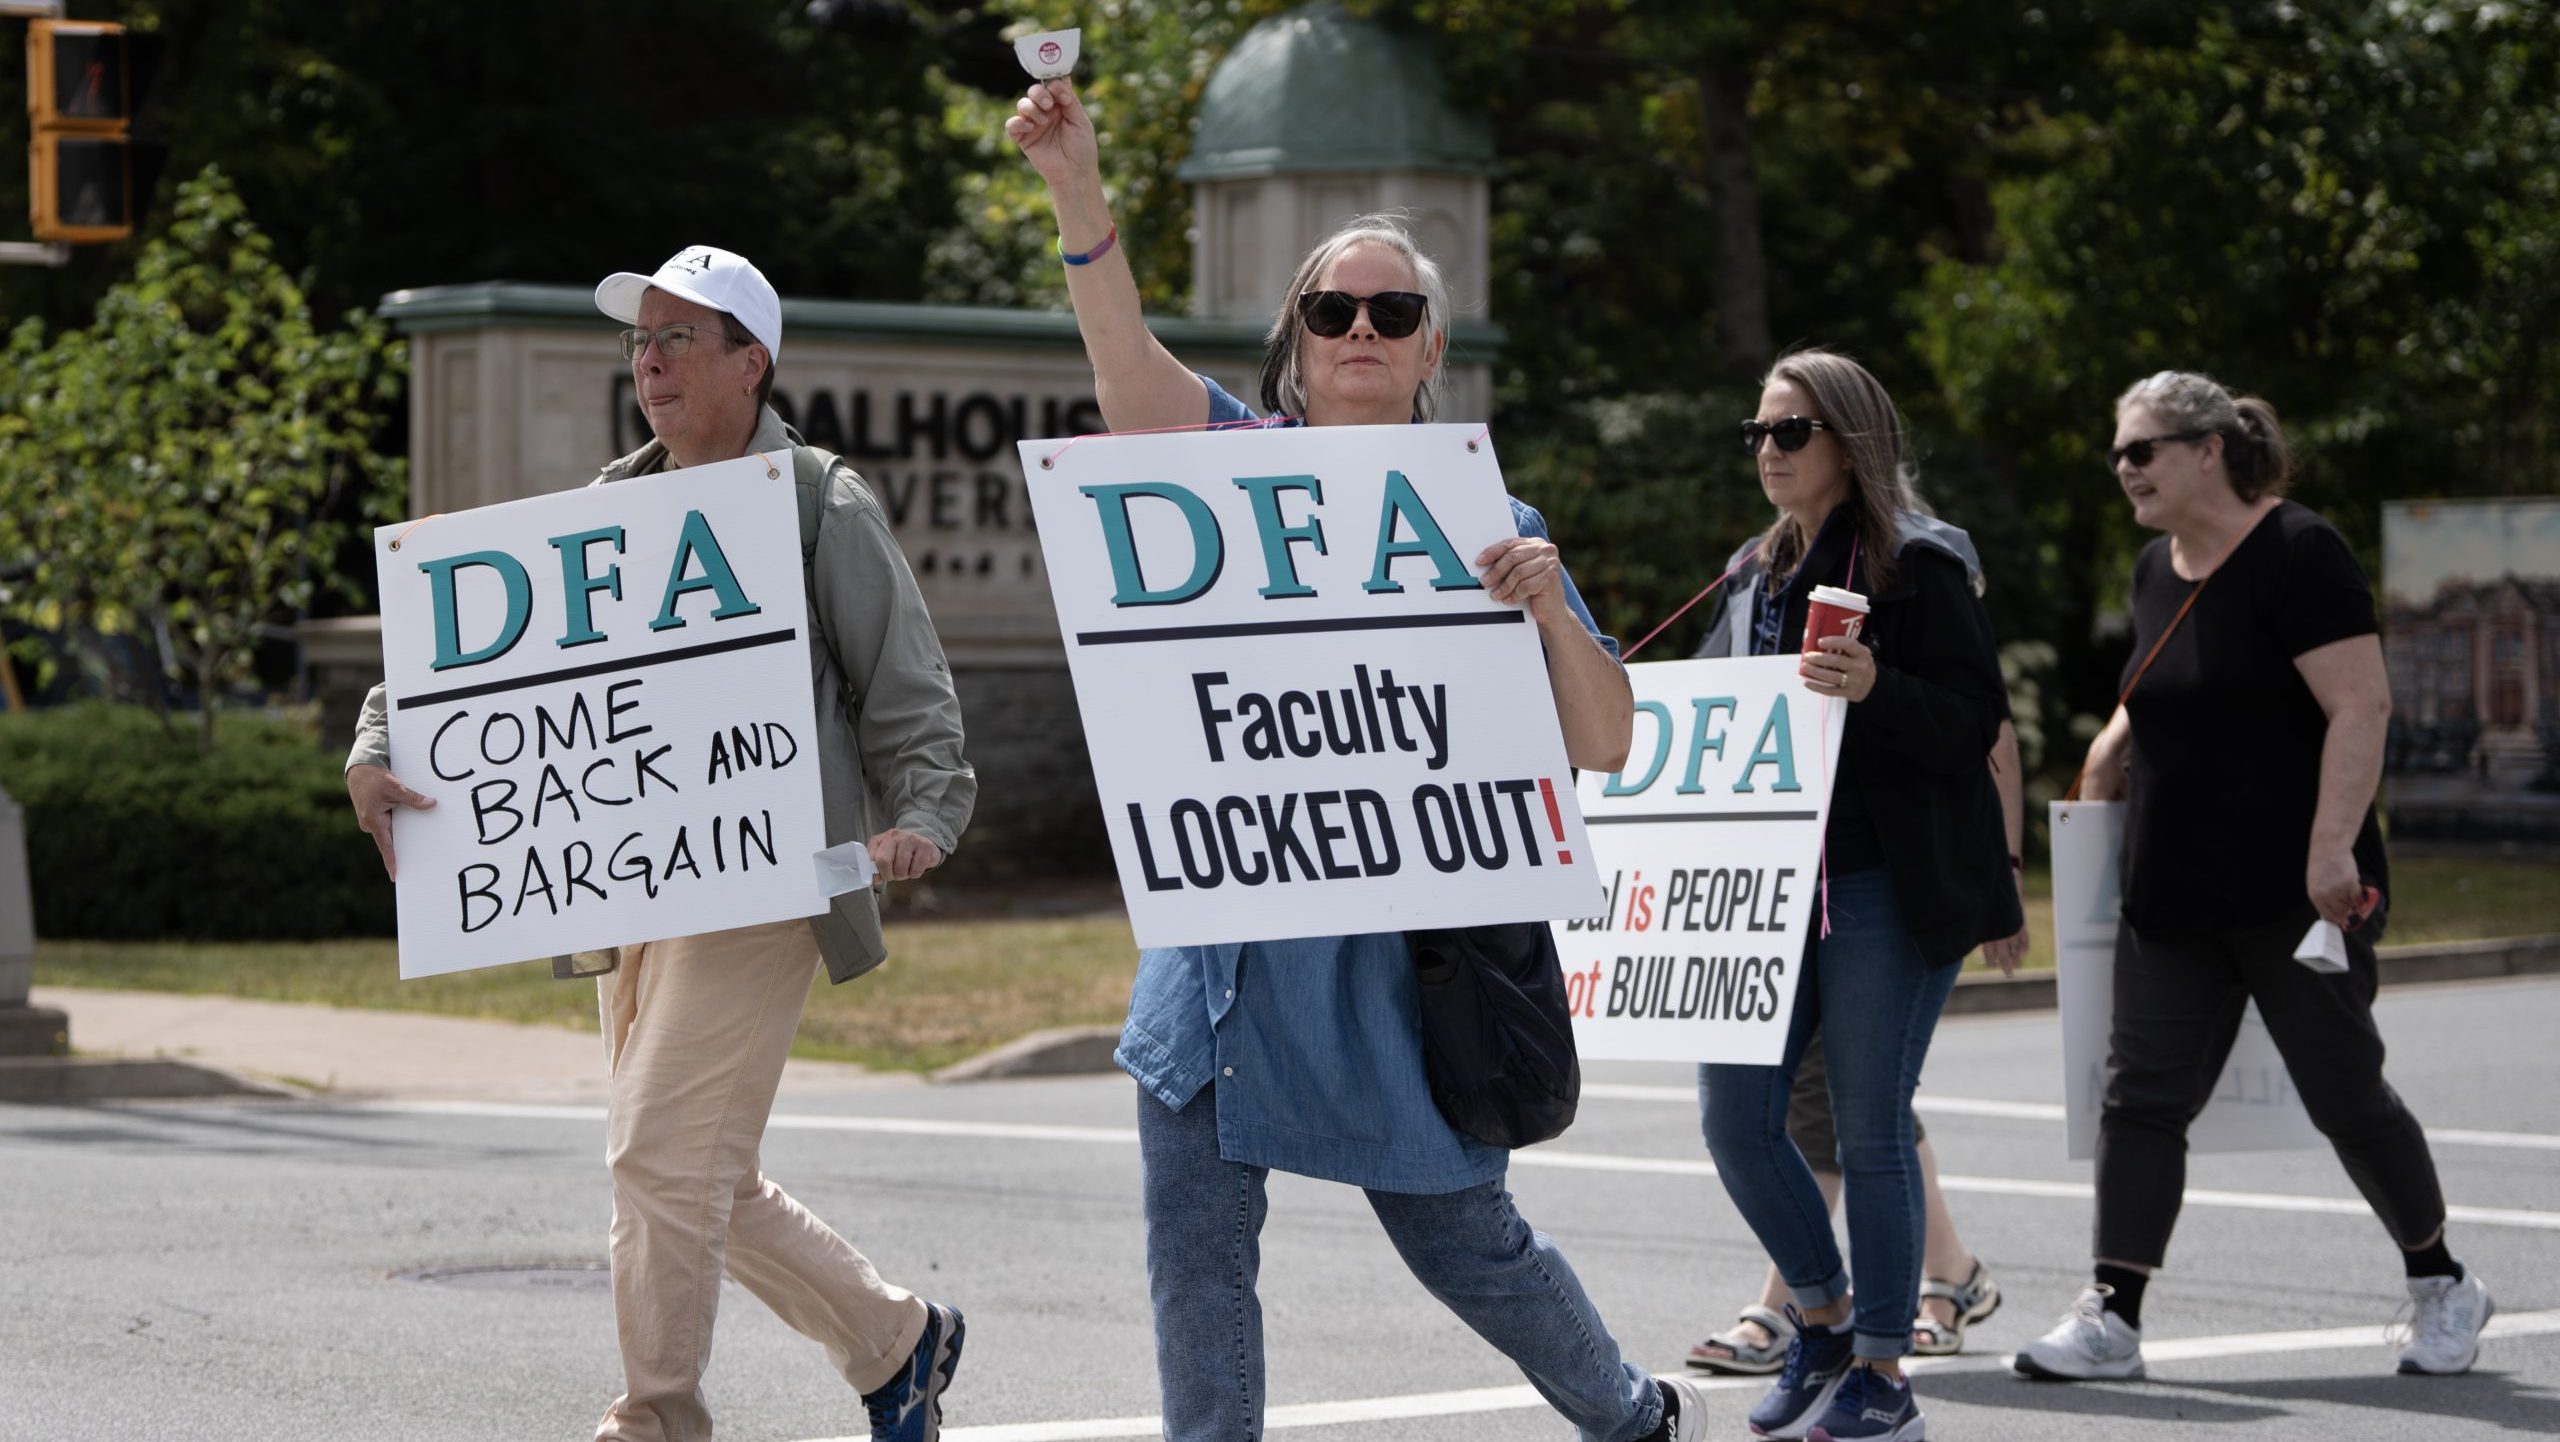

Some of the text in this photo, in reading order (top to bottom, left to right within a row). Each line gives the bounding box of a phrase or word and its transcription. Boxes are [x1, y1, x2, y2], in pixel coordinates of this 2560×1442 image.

[418, 509, 762, 672] DFA
[1078, 469, 1484, 608] DFA
[430, 678, 653, 782] COME
[1191, 664, 1448, 770] Faculty
[1602, 693, 1803, 798] DFA
[470, 722, 798, 846] BACK AND
[1126, 778, 1573, 892] LOCKED OUT!
[457, 809, 778, 933] BARGAIN
[1624, 870, 1656, 932] is
[1662, 868, 1796, 933] PEOPLE
[1562, 955, 1785, 1022] ot BUILDINGS
